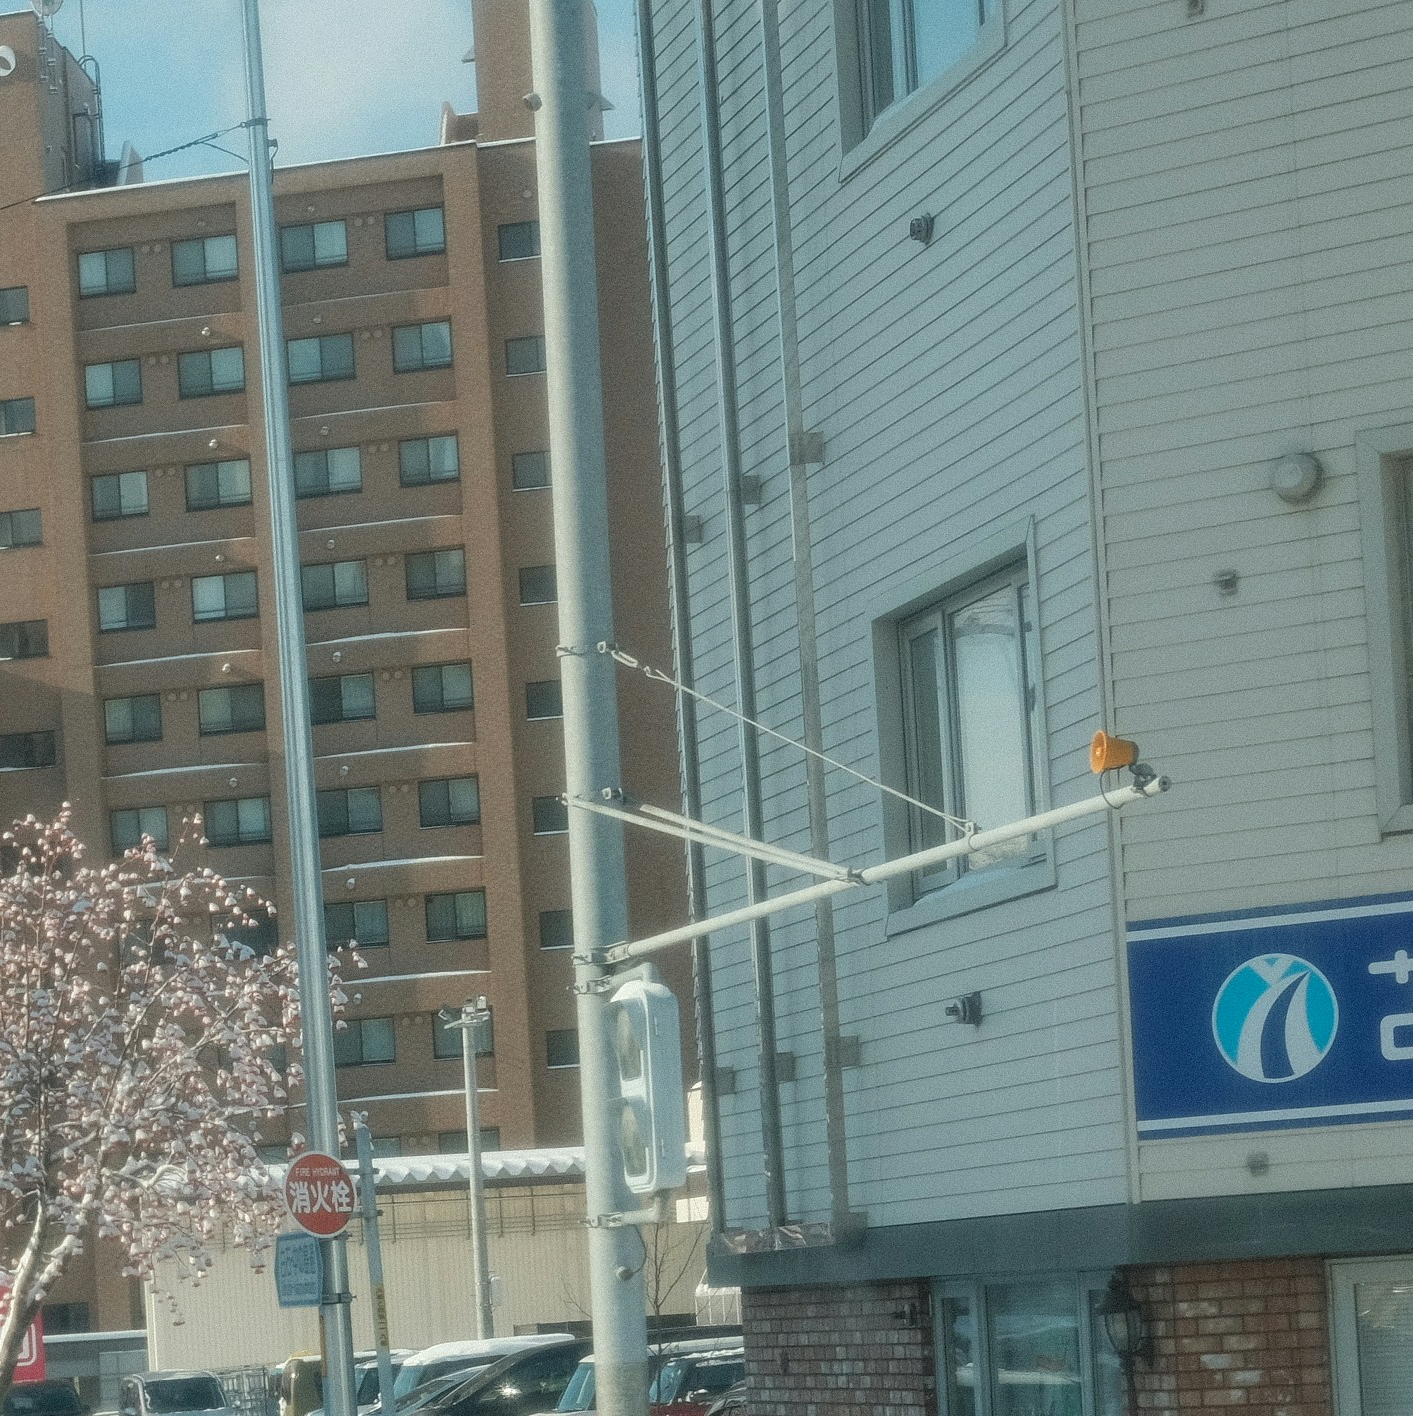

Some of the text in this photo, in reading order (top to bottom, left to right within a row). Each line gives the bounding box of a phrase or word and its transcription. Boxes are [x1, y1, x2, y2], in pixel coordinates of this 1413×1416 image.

[295, 1167, 341, 1176] FIRE HYDRANT
[288, 1180, 352, 1213] 消火栓
